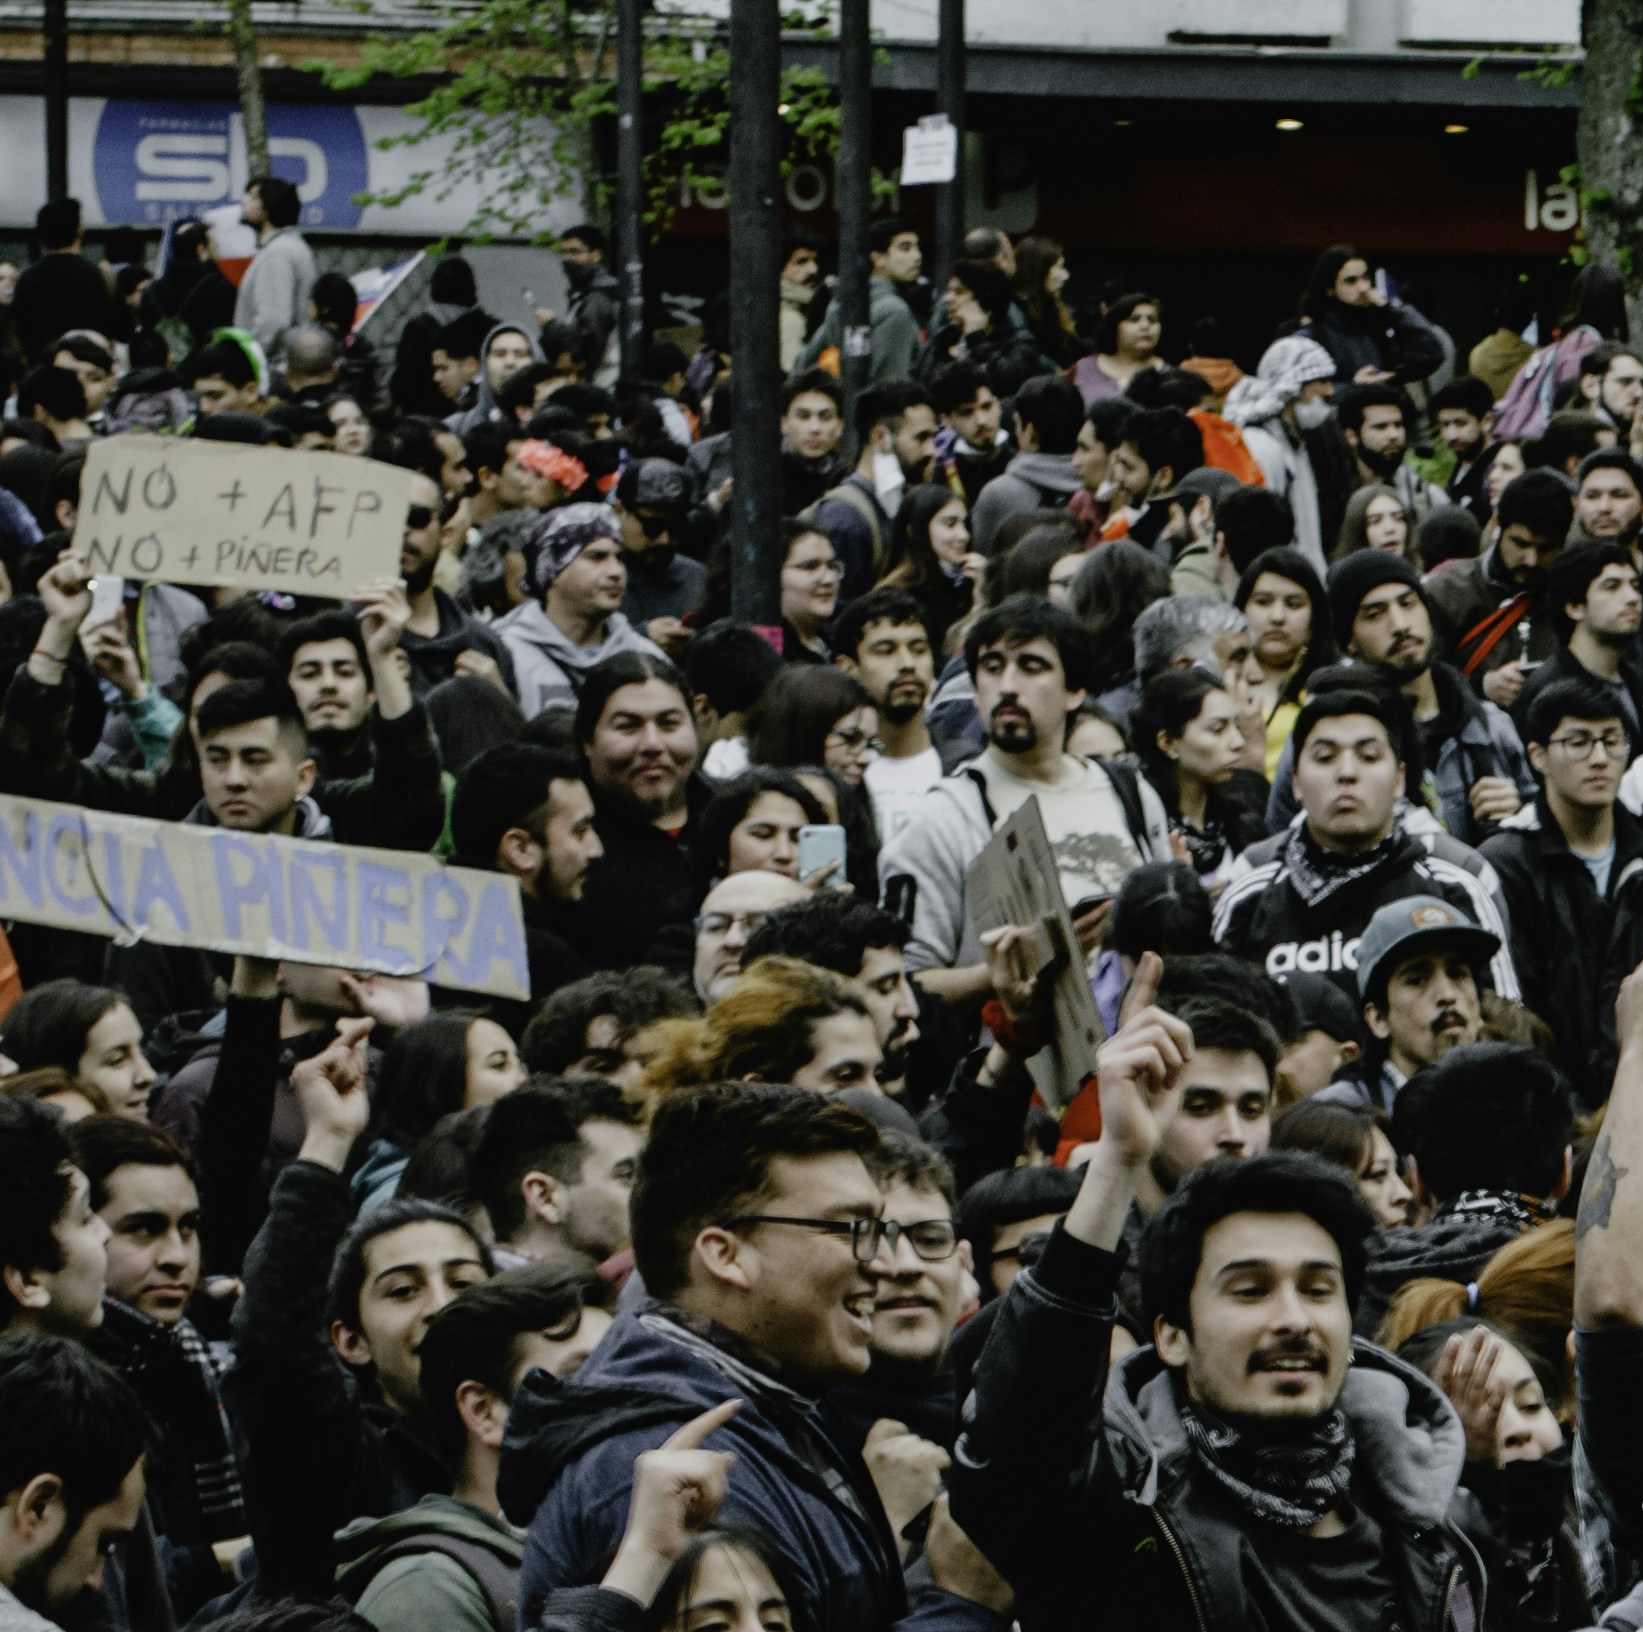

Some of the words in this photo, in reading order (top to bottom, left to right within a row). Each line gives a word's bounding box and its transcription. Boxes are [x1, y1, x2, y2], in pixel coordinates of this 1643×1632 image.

[92, 461, 177, 516] NO
[262, 474, 383, 540] AFP
[86, 532, 163, 574] NO
[210, 834, 530, 990] PIÑERA
